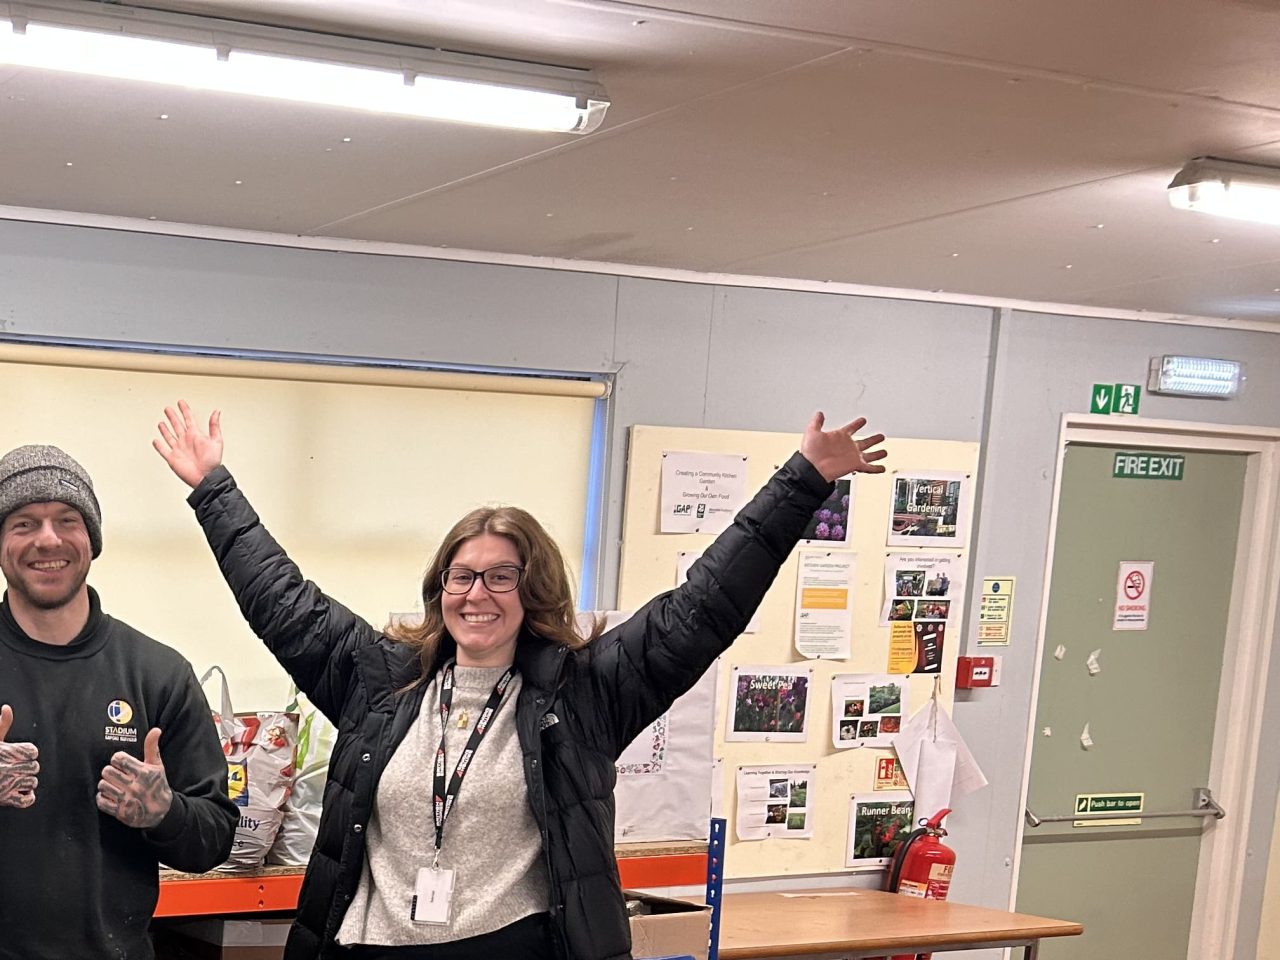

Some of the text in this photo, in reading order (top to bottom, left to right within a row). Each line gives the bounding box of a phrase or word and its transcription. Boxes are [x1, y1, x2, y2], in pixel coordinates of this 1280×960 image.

[1114, 455, 1184, 477] FIRE EXIT
[914, 483, 944, 494] Vertical
[906, 503, 946, 515] Gardening
[749, 679, 793, 690] Sweet Pea
[104, 726, 137, 735] STADIUM
[1091, 800, 1105, 808] Push
[861, 806, 890, 816] Runner
